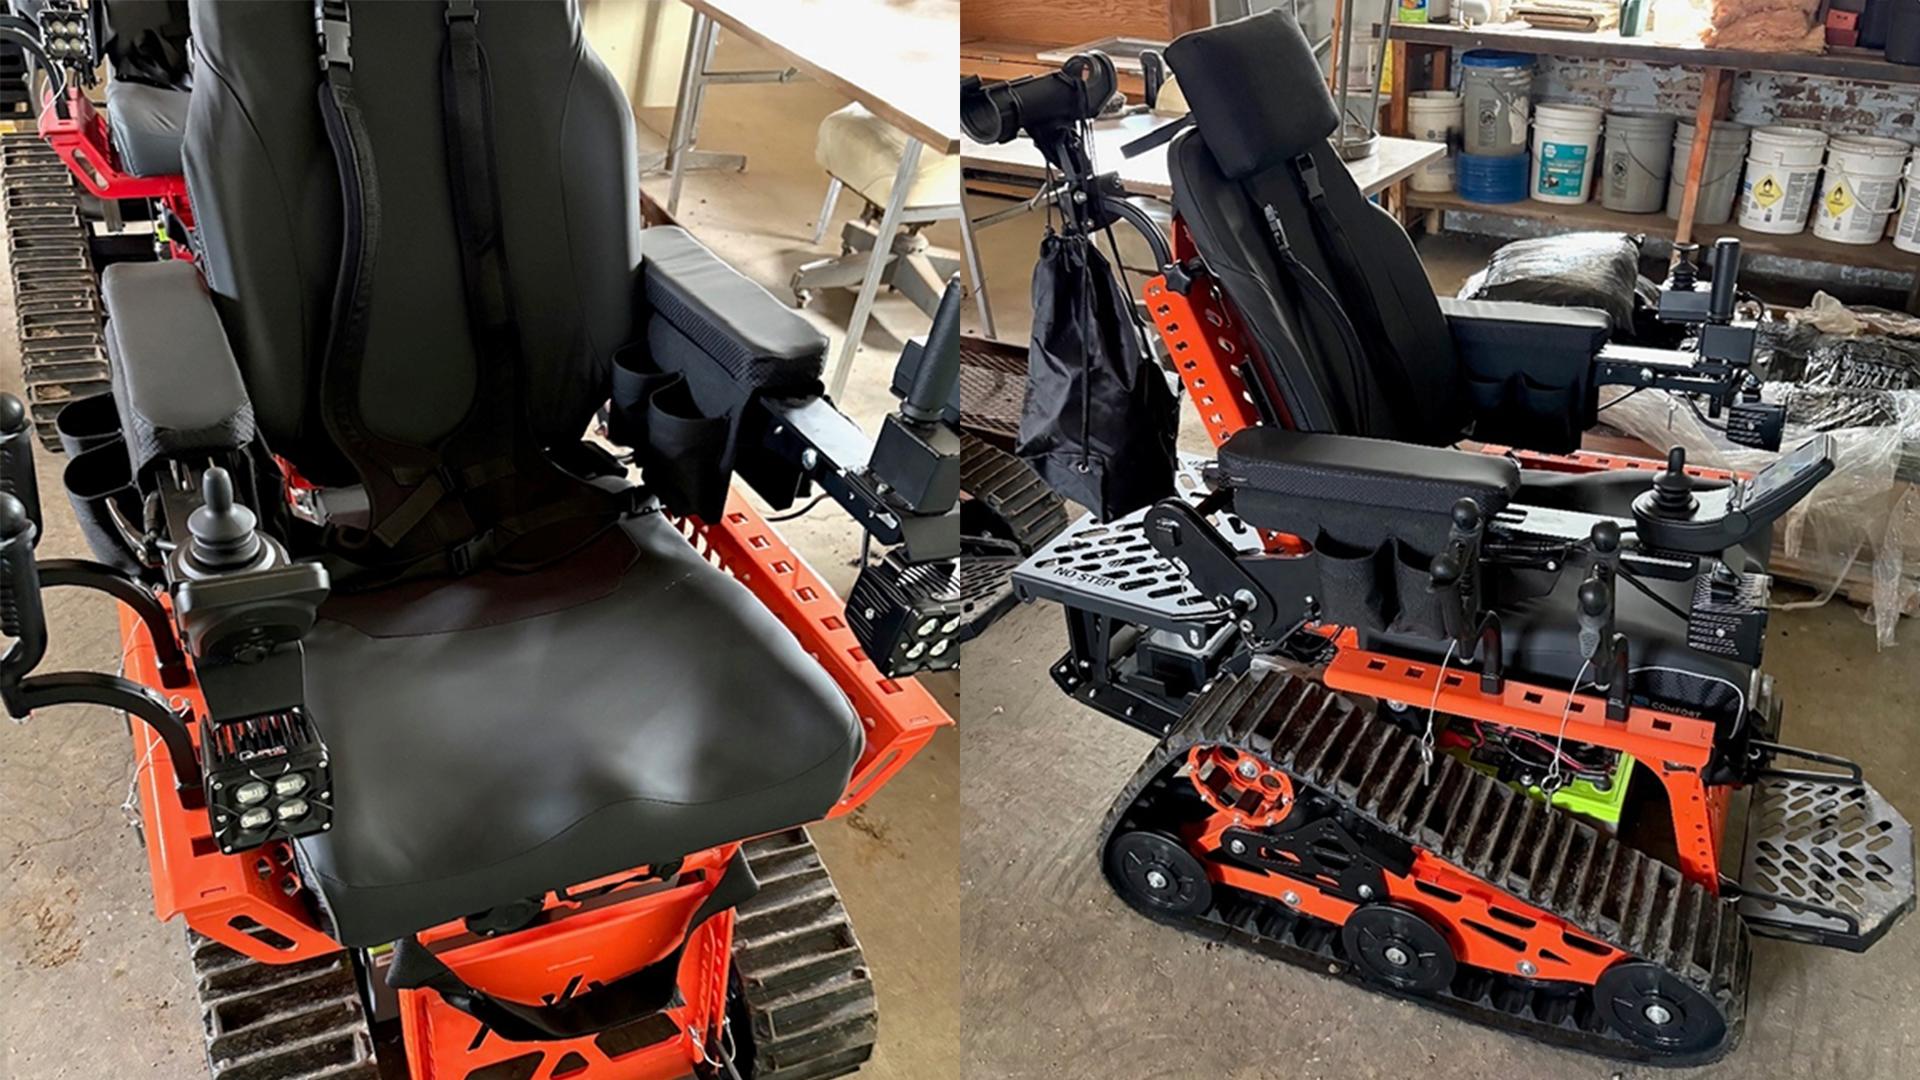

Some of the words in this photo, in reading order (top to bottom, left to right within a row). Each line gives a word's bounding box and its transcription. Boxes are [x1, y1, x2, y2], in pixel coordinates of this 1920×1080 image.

[1053, 566, 1077, 578] NO
[1077, 573, 1116, 587] STEP
[1651, 701, 1702, 718] COMFORT
